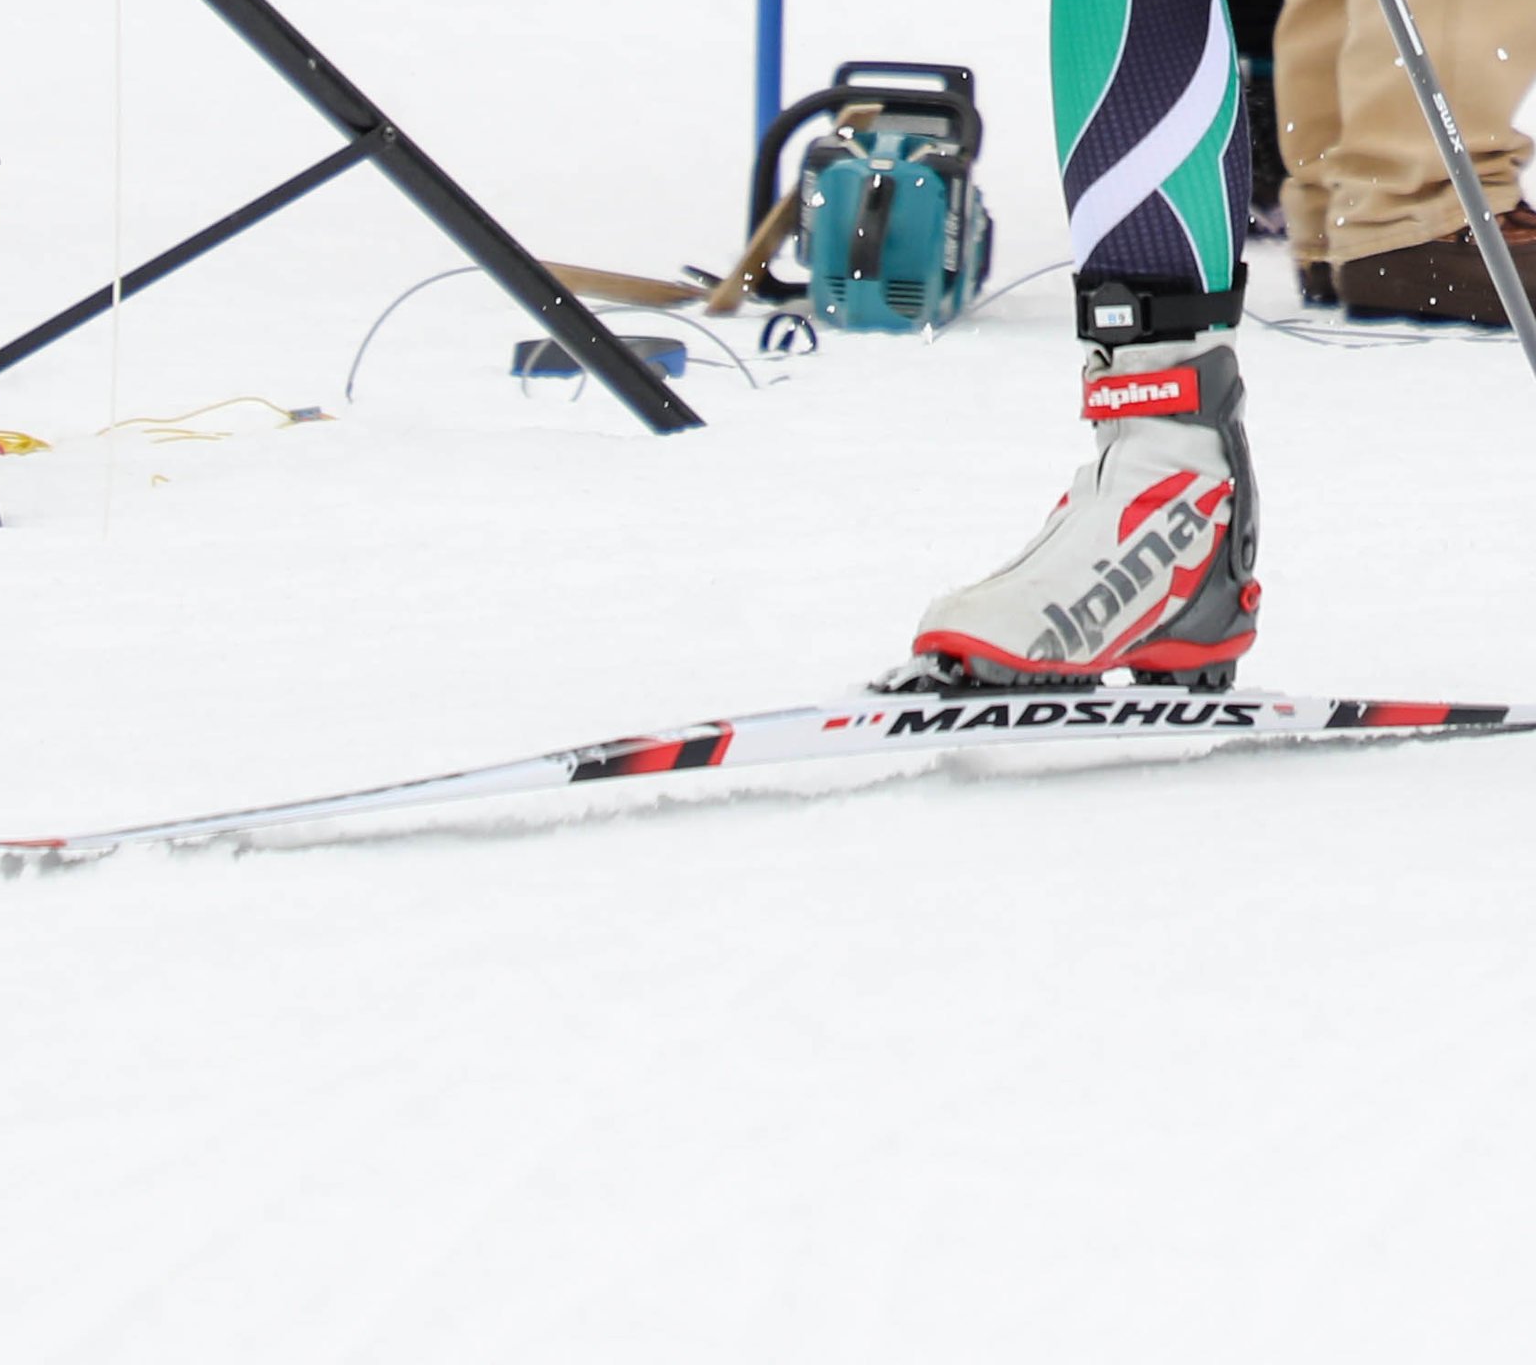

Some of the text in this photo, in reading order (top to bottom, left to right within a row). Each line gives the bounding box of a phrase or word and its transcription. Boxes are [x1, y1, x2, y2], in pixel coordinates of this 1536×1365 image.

[1088, 378, 1180, 410] alpina
[1026, 495, 1210, 662] alpina
[885, 700, 1264, 738] MADSHUS
